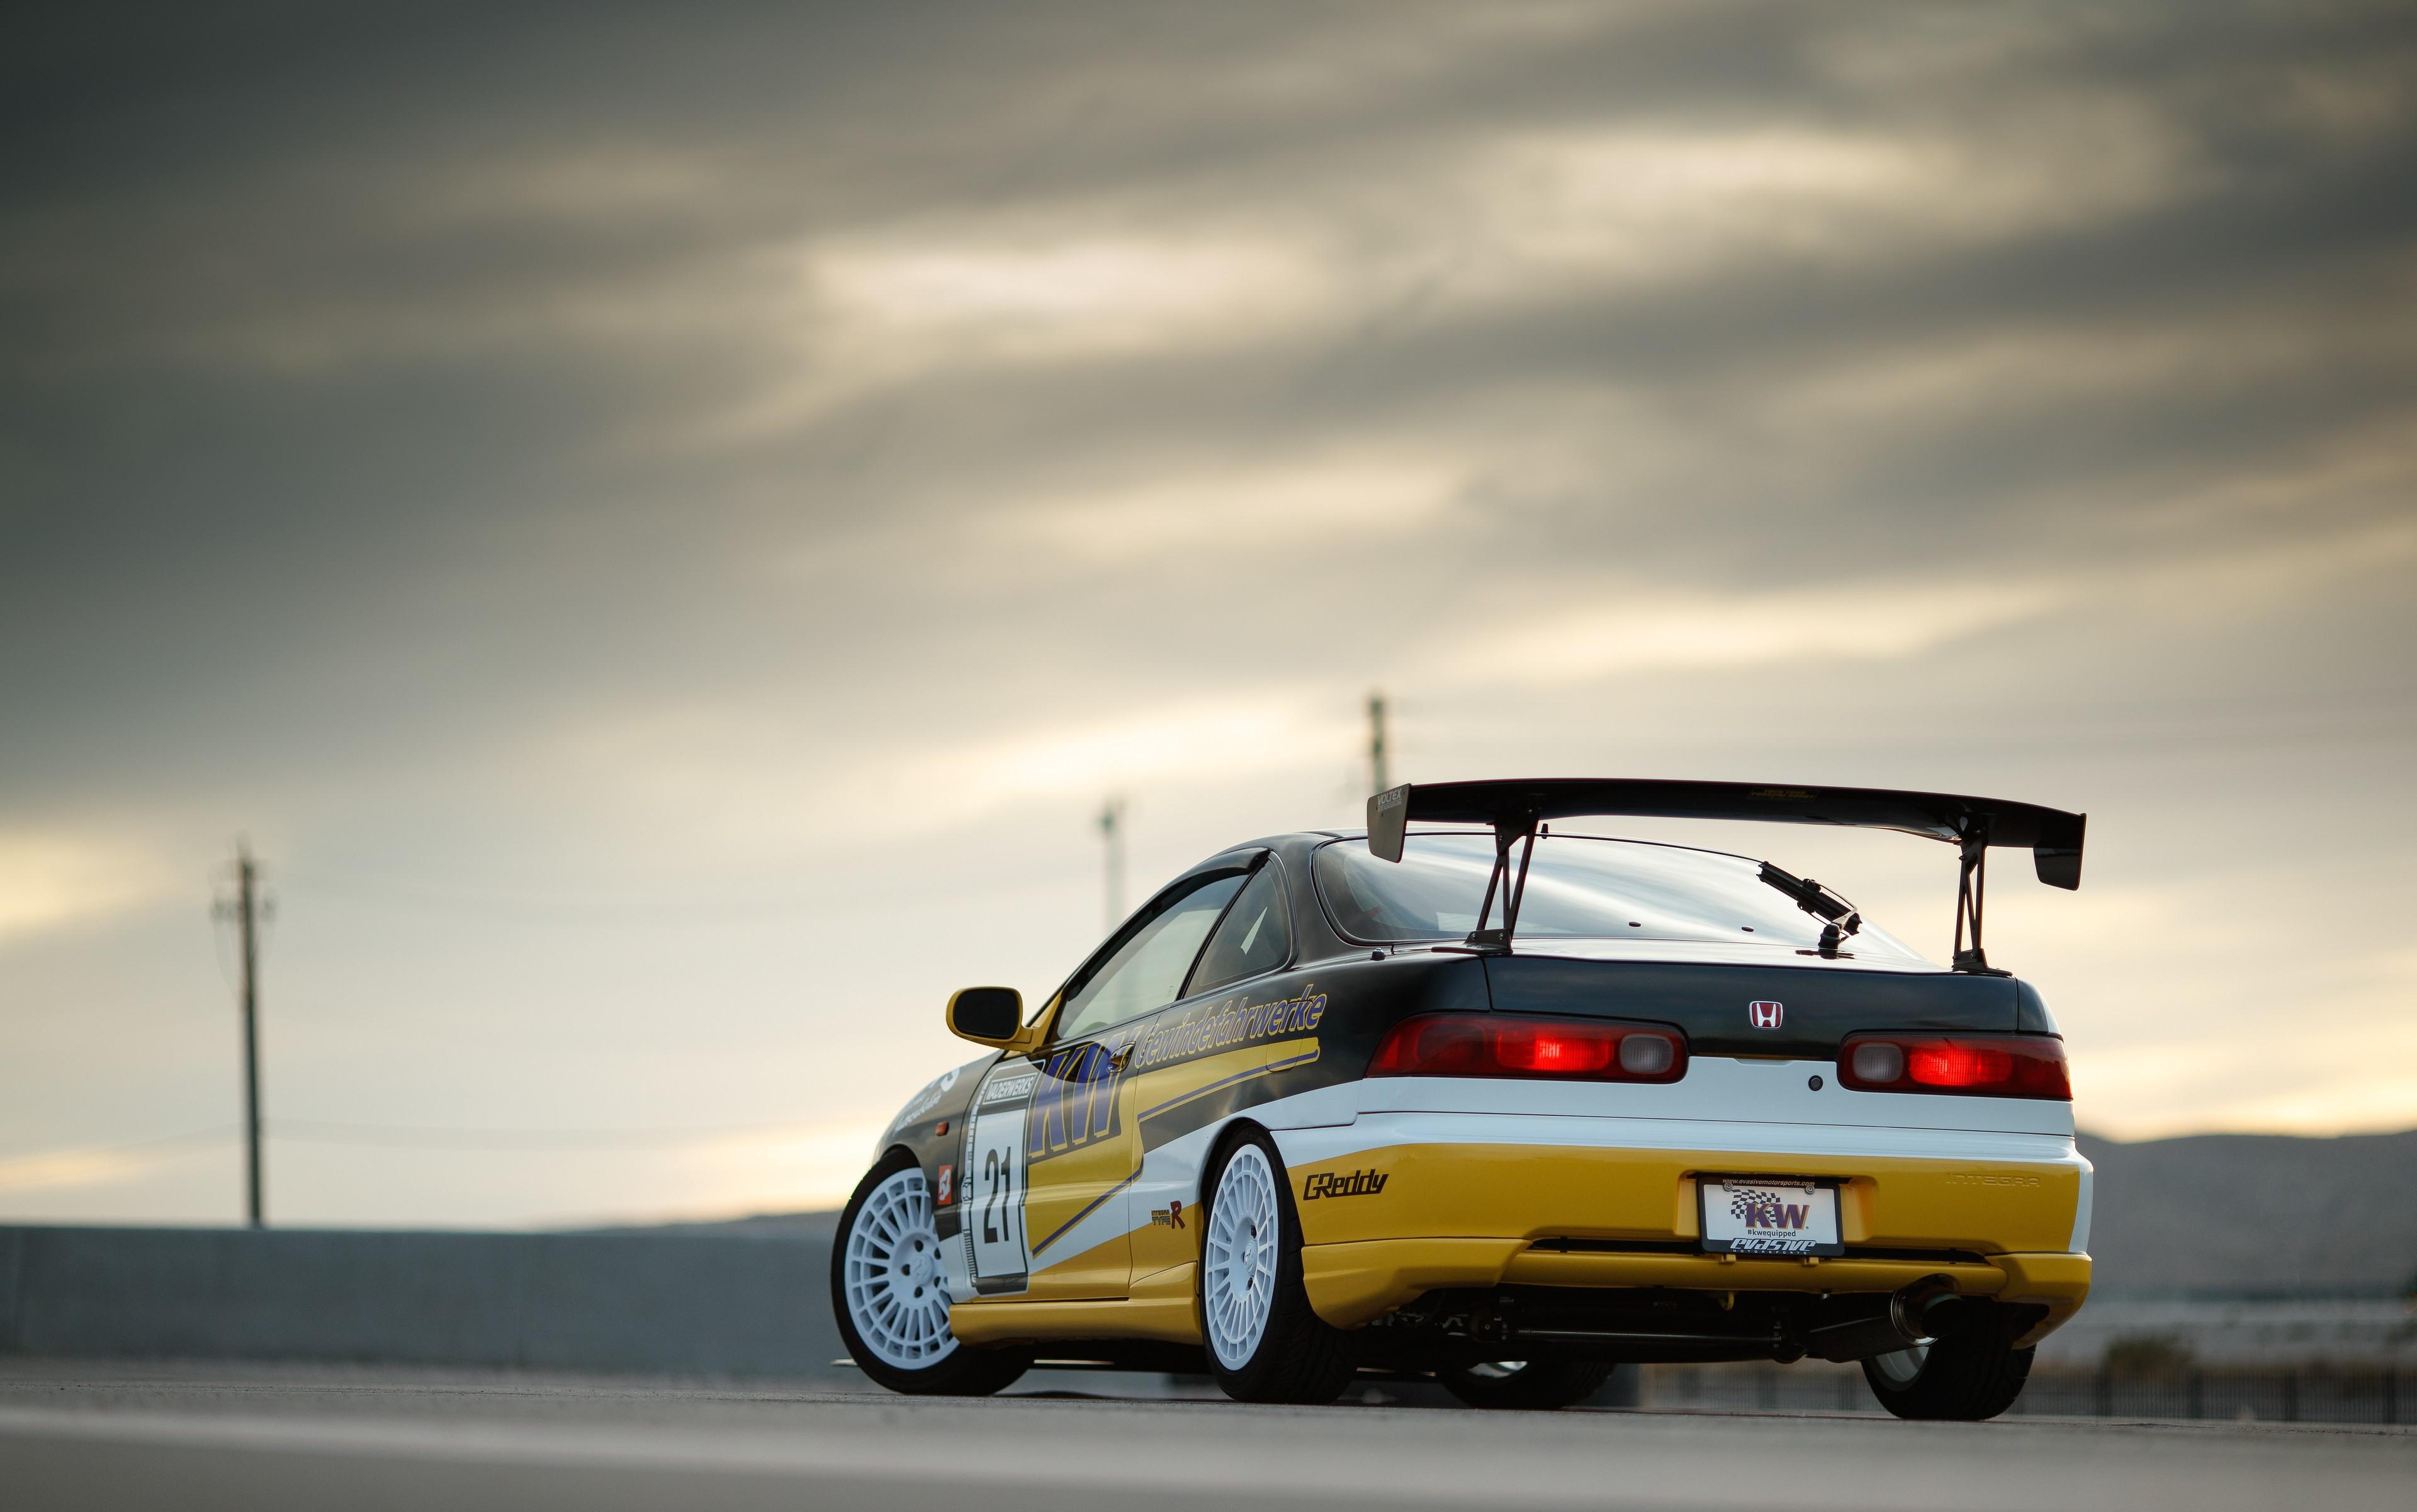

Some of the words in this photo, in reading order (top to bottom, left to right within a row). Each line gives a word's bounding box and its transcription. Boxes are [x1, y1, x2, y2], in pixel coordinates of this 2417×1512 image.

[1377, 787, 1402, 806] VOLTEX
[1028, 1025, 1144, 1158] KW
[1134, 983, 1327, 1068] Gewindefahrwerke
[1303, 1169, 1389, 1200] GReddy
[1722, 1178, 1815, 1187] www.evasivemotorsports.com
[1946, 1173, 2041, 1187] INTEGRA
[984, 1146, 1011, 1244] 21
[1152, 1216, 1171, 1226] TYPE
[1169, 1200, 1185, 1229] R
[1745, 1202, 1811, 1231] KW
[1747, 1229, 1796, 1238] #kwequipped
